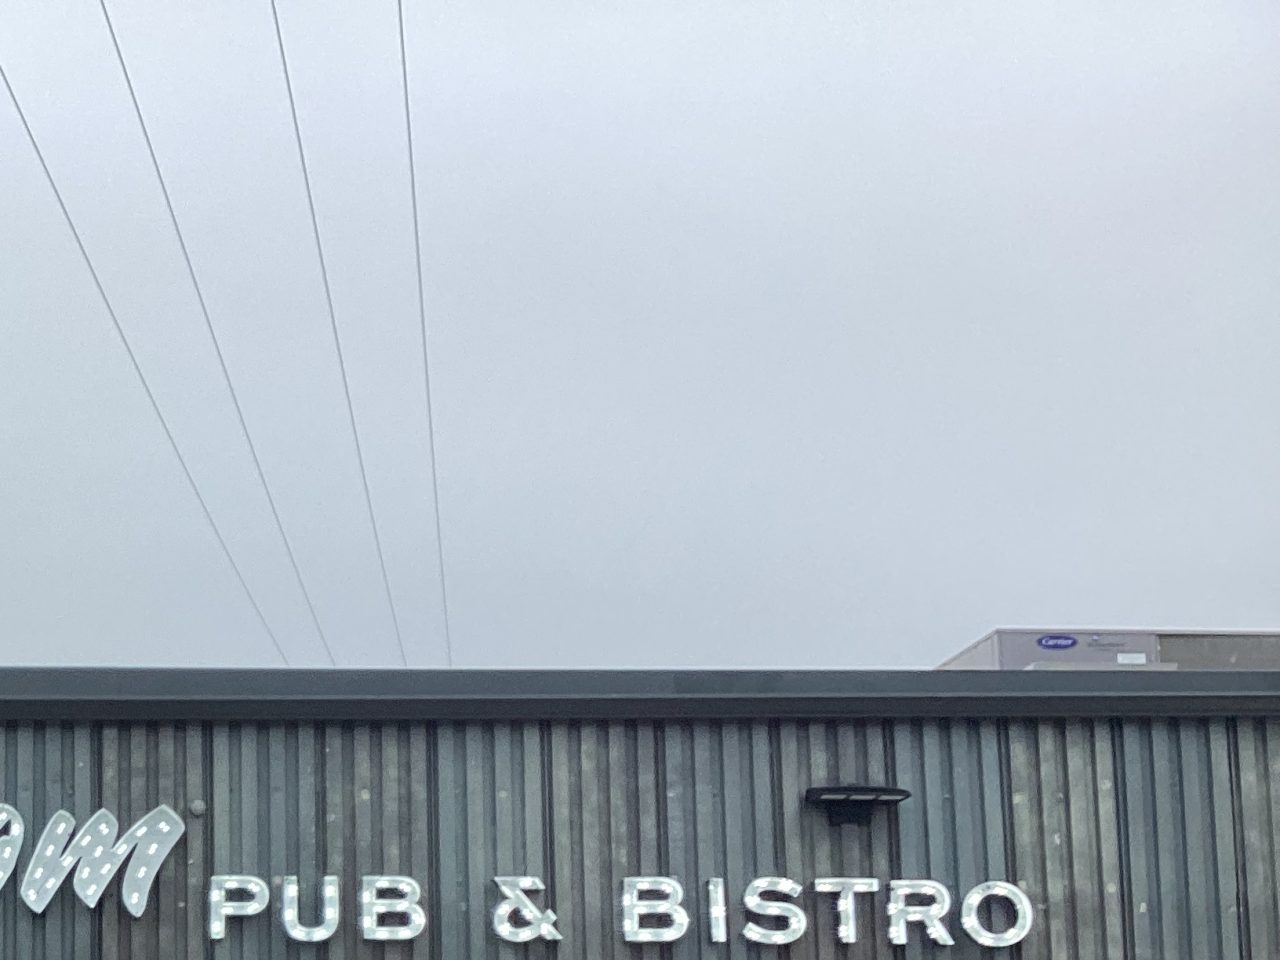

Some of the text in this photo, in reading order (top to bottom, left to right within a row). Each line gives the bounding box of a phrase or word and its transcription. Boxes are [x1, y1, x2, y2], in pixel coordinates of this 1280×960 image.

[209, 875, 1034, 948] PUB & BISTRO
